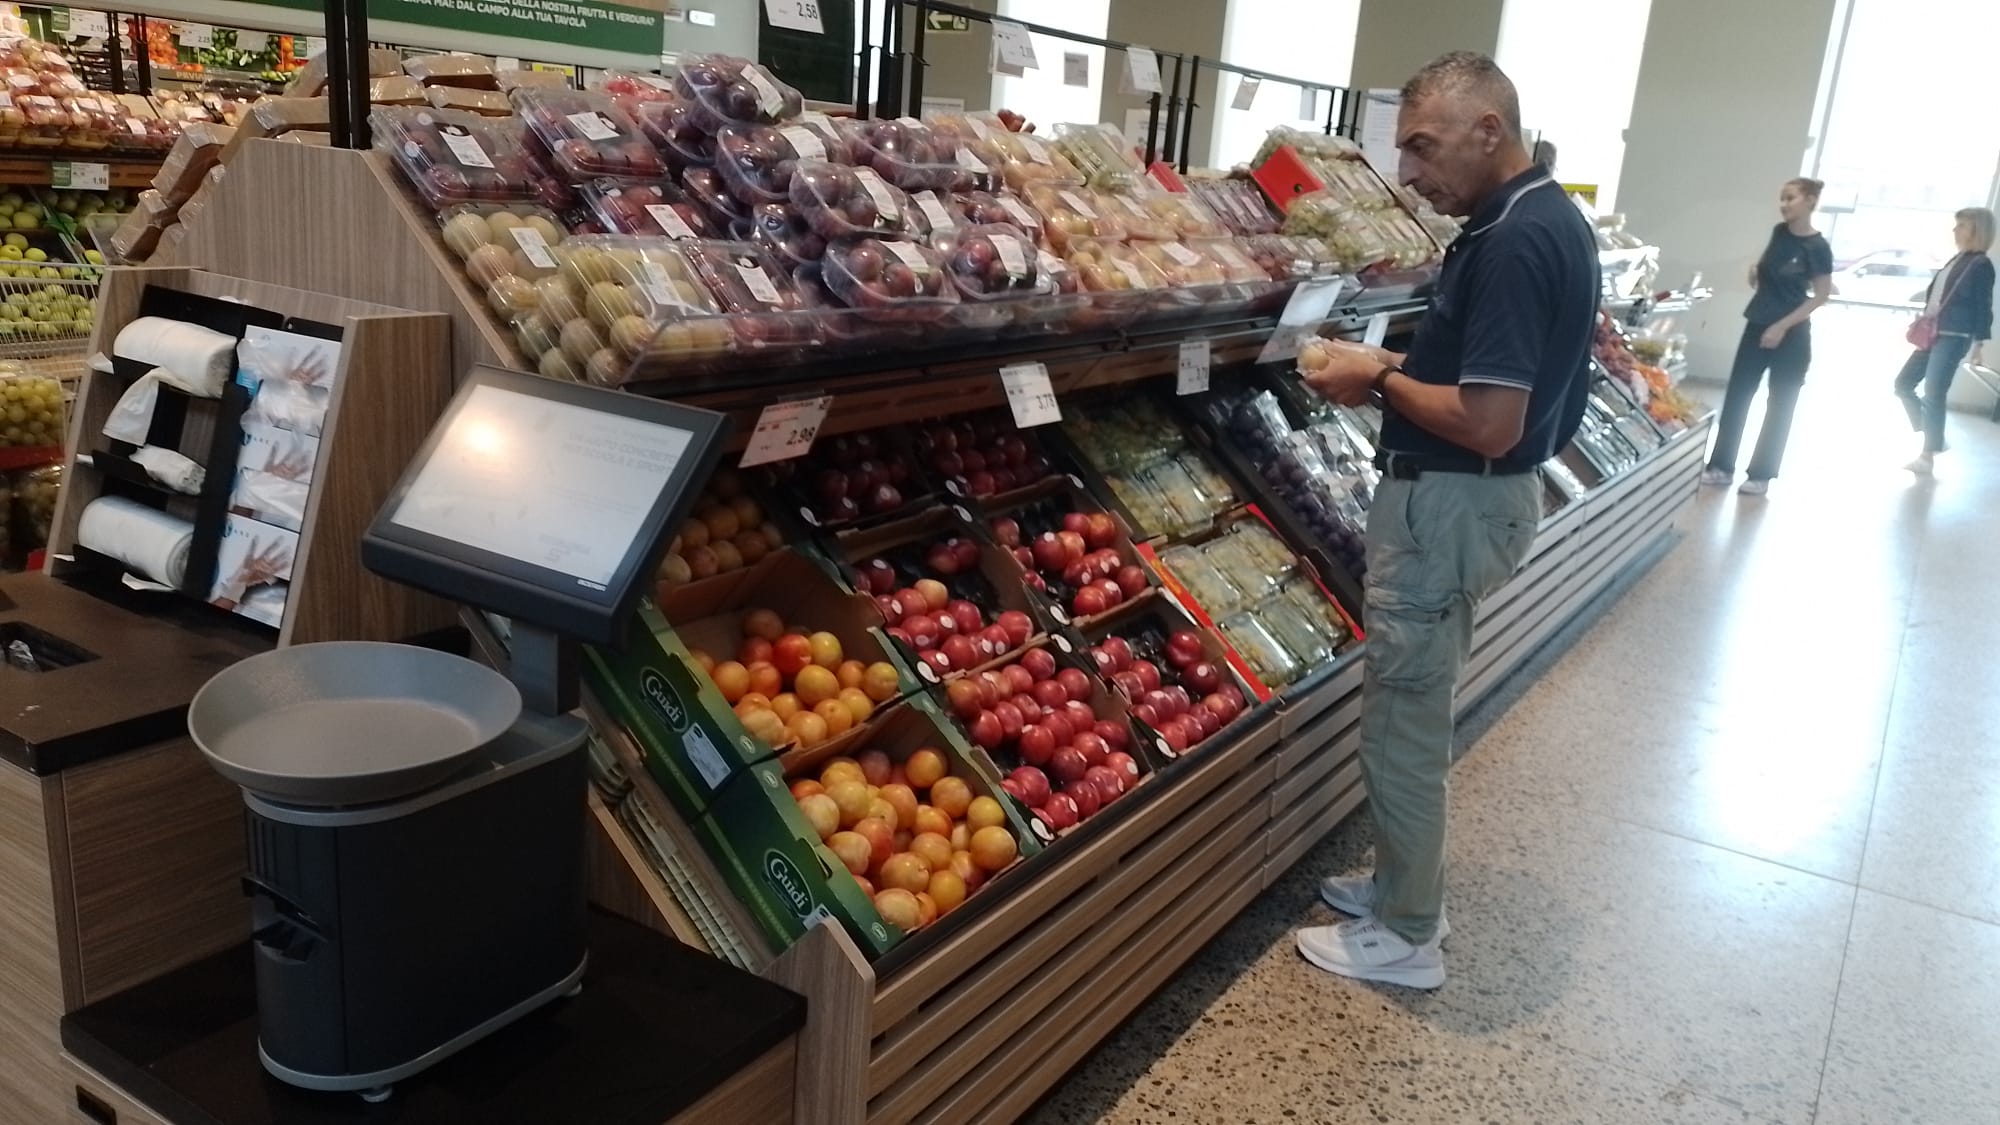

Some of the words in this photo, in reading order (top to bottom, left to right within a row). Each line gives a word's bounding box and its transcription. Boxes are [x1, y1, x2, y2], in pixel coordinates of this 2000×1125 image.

[456, 1, 476, 12] DAL
[477, 3, 510, 16] CAMPO
[511, 7, 534, 20] ALLA
[535, 11, 553, 23] TUA
[553, 14, 587, 28] TAVOLA
[541, 1, 576, 14] NOSTRA
[577, 6, 607, 19] FRUTTA
[609, 11, 615, 20] E
[615, 12, 656, 26] VERDURA?
[770, 858, 809, 909] Guidi
